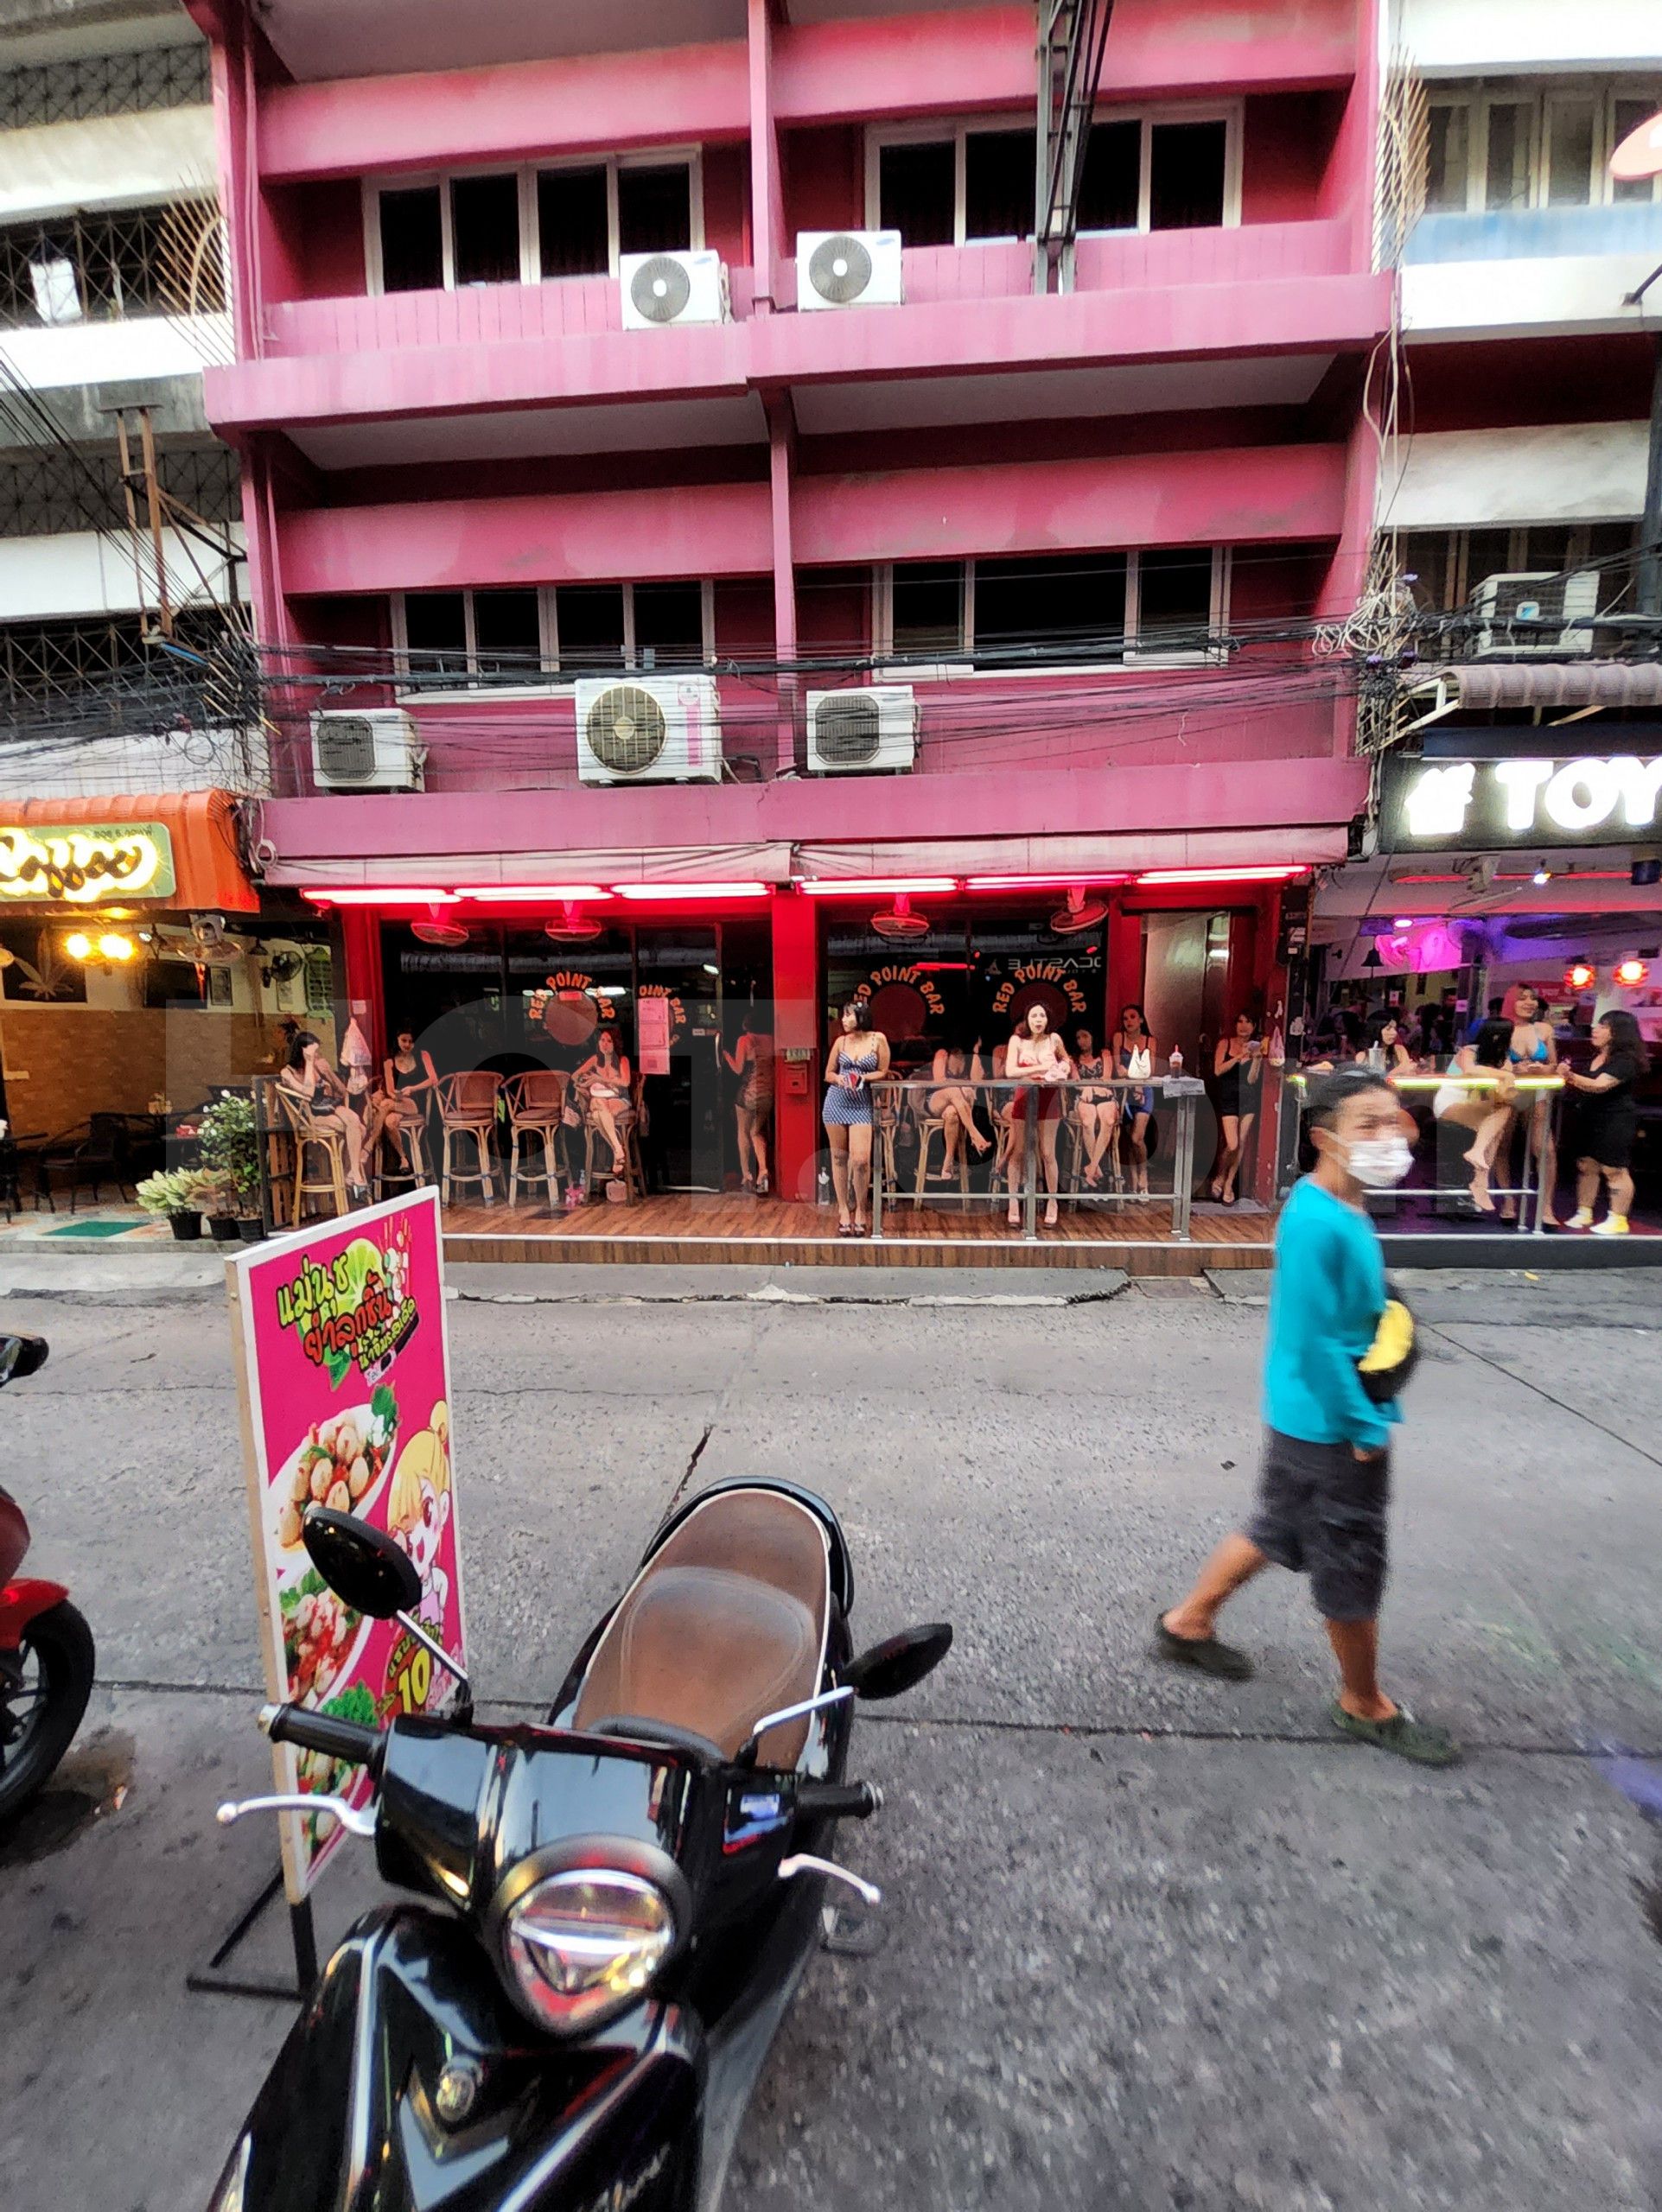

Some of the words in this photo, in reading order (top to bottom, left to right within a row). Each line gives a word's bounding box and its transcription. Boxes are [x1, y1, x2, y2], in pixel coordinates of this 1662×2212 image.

[1495, 757, 1662, 830] TOY
[529, 988, 550, 1020] RED
[546, 970, 592, 991] POINT
[595, 986, 616, 1020] BAR
[639, 984, 672, 998] OINT
[669, 997, 687, 1025] BAR
[853, 982, 872, 1004] ED
[870, 964, 921, 986] POINT
[920, 981, 946, 1015] BAR
[992, 982, 1015, 1014] RED
[1014, 964, 1067, 983] POINT
[1063, 979, 1087, 1013] BAR
[398, 1646, 434, 1714] 10
